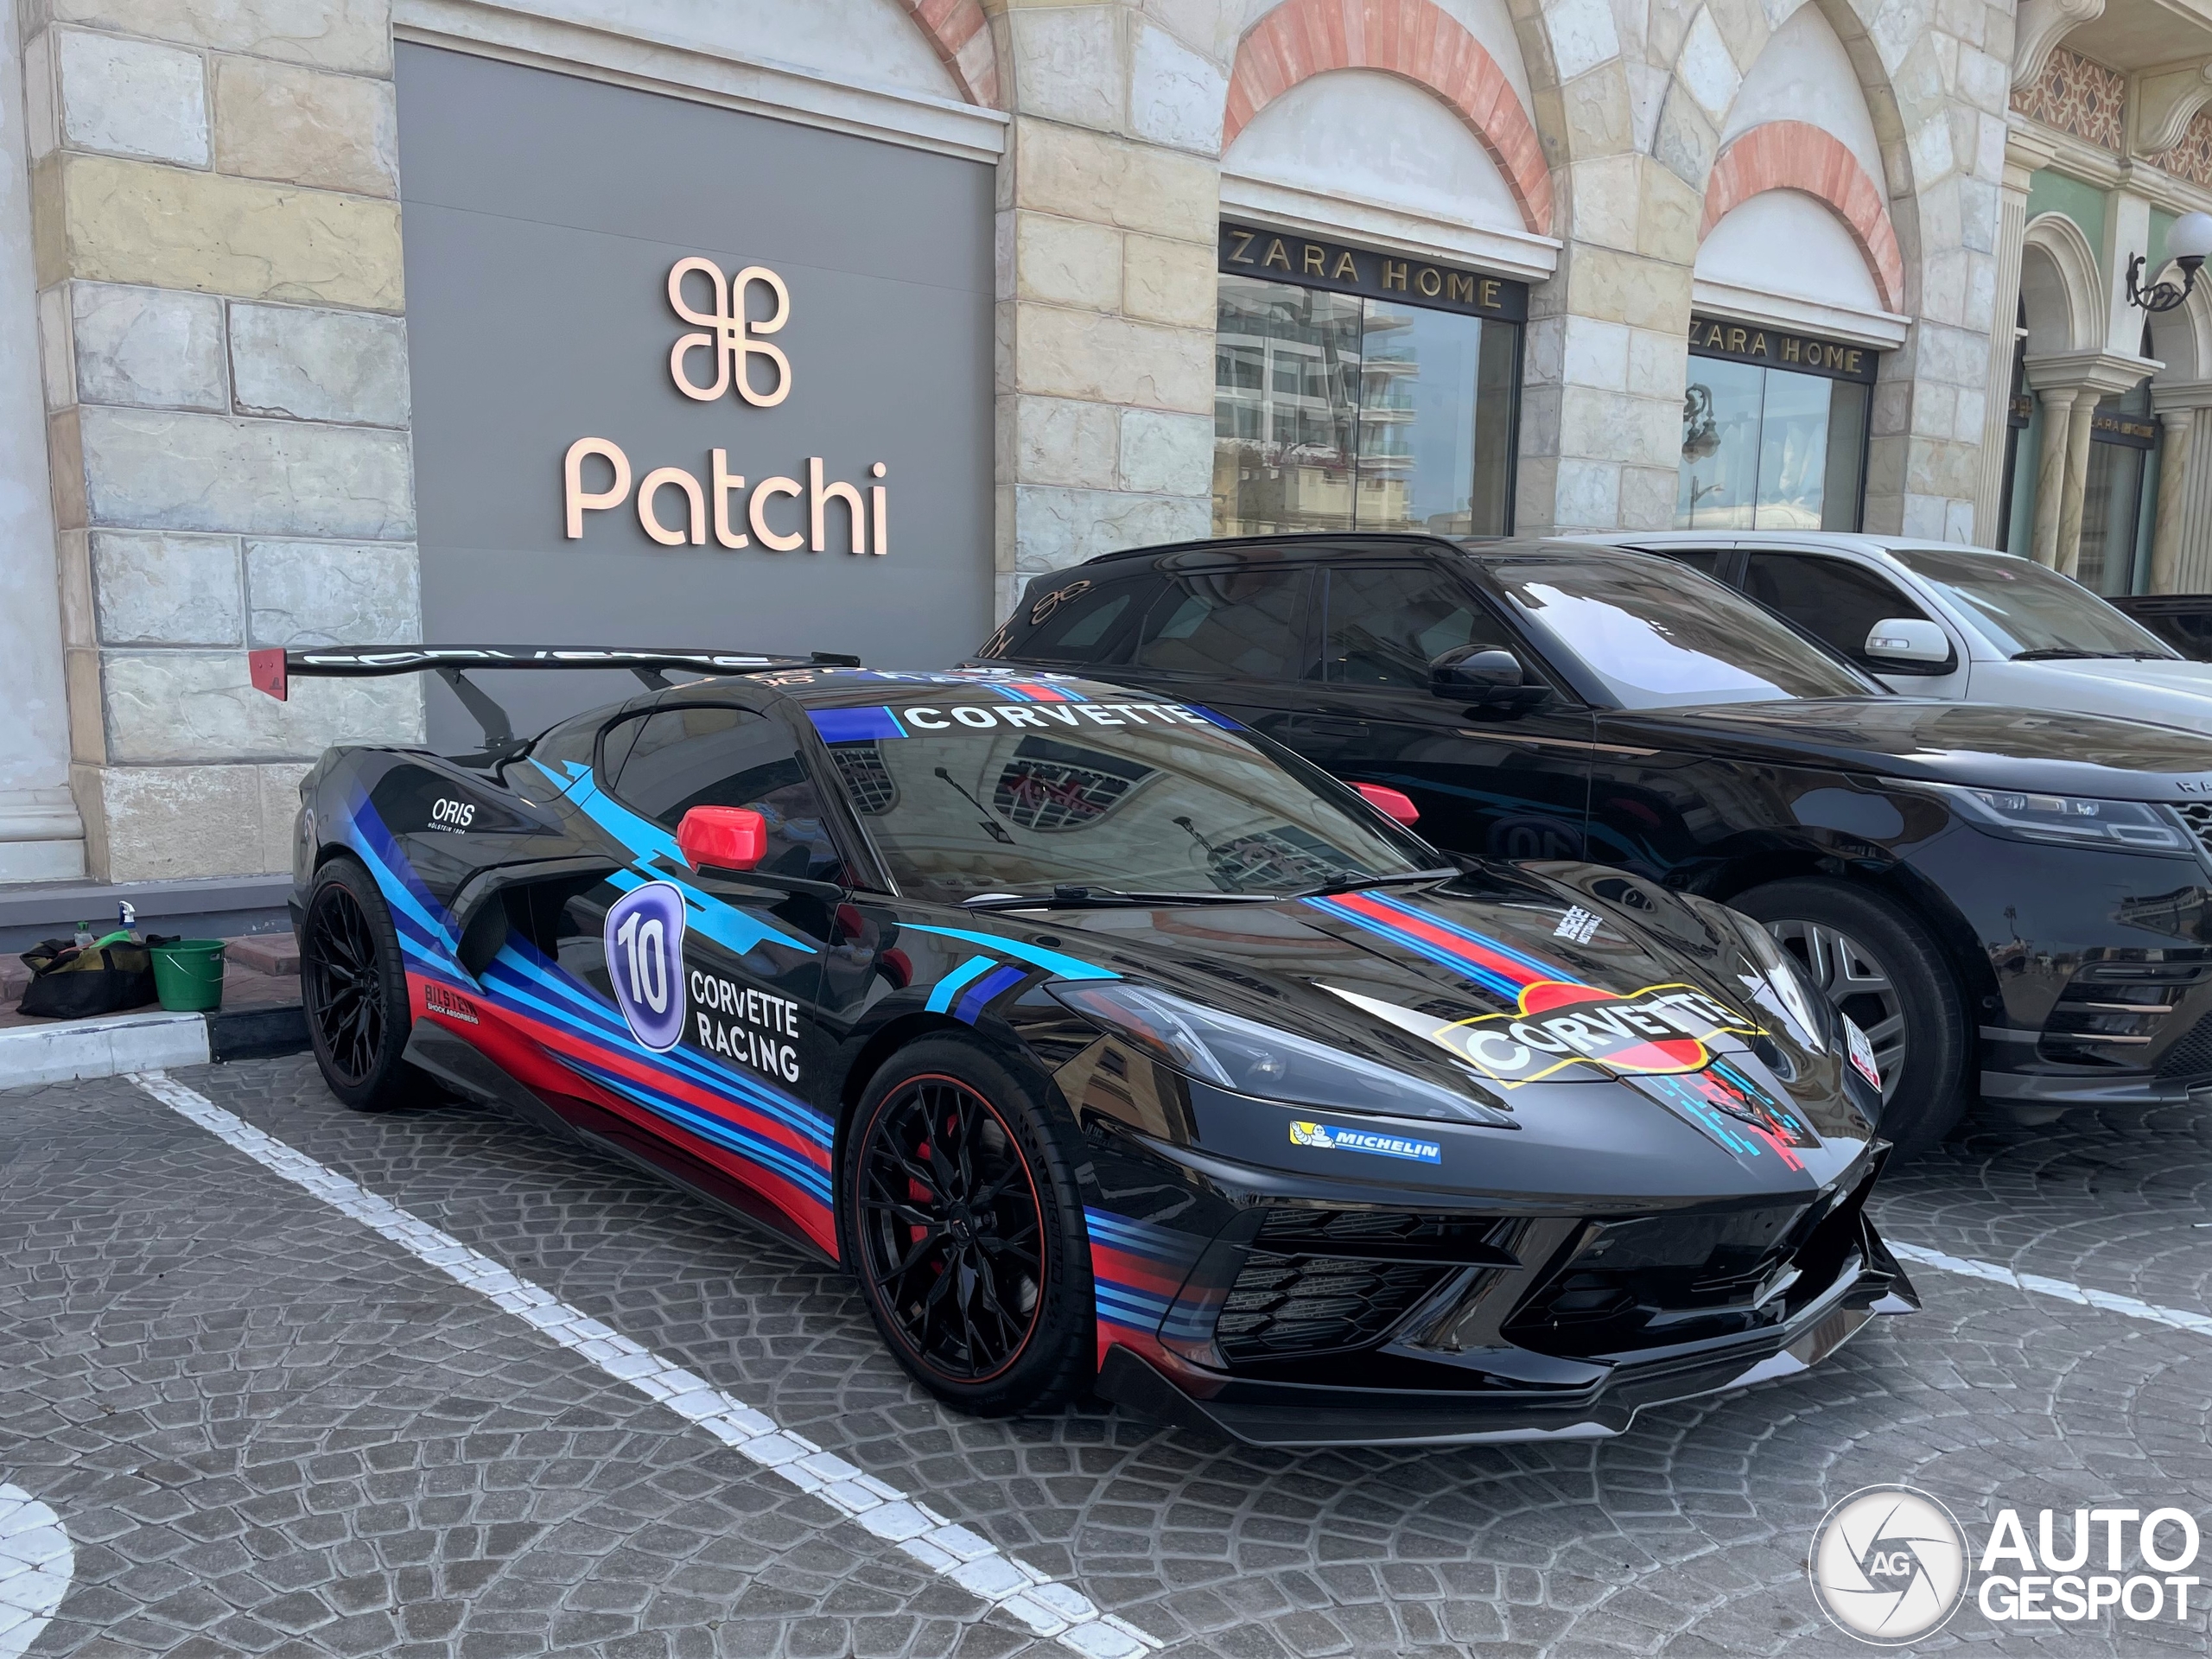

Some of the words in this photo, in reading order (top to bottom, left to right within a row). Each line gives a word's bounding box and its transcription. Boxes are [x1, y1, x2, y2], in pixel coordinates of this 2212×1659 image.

[1228, 230, 1359, 283] ZARA
[1382, 259, 1502, 308] HOME
[1688, 320, 1768, 357] ZARA
[1781, 338, 1862, 373] HOME
[564, 436, 887, 555] Patchi
[903, 703, 1211, 729] CORVETTE
[432, 798, 475, 827] ORIS
[617, 911, 668, 1014] 10
[424, 984, 479, 1017] BILSTEIN
[427, 1002, 446, 1015] SHOCK
[446, 1008, 480, 1026] ABSORBERS
[690, 969, 799, 1039] CORVETTE
[696, 1011, 799, 1083] RACING
[1465, 993, 1744, 1071] CORVETTE
[1335, 1131, 1439, 1157] MICHELIN
